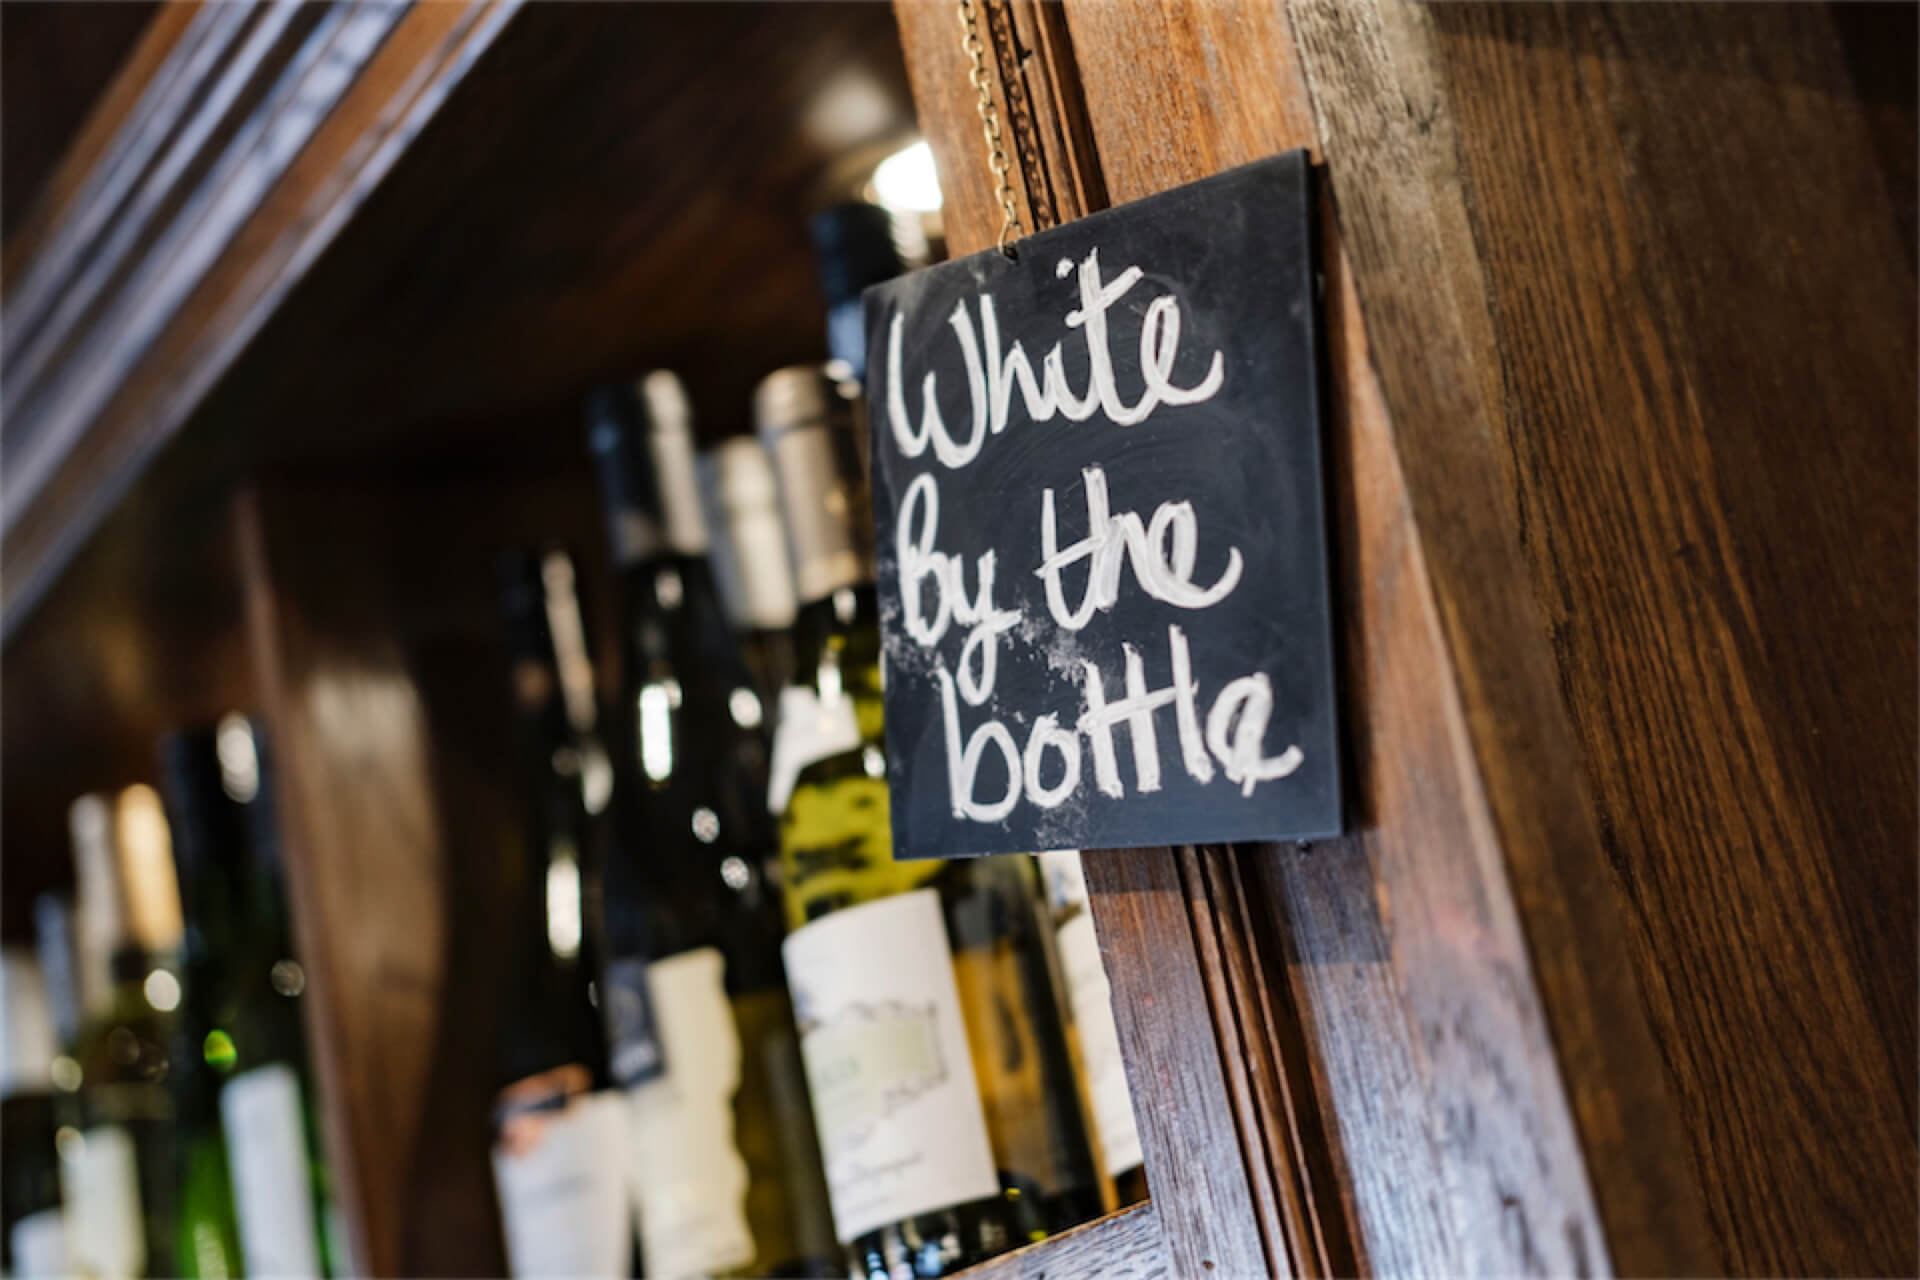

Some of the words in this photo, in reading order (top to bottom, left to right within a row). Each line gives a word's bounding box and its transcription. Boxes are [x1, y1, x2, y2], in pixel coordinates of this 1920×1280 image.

[888, 247, 1224, 468] White
[1033, 464, 1243, 631] the
[938, 624, 1303, 823] bottle
